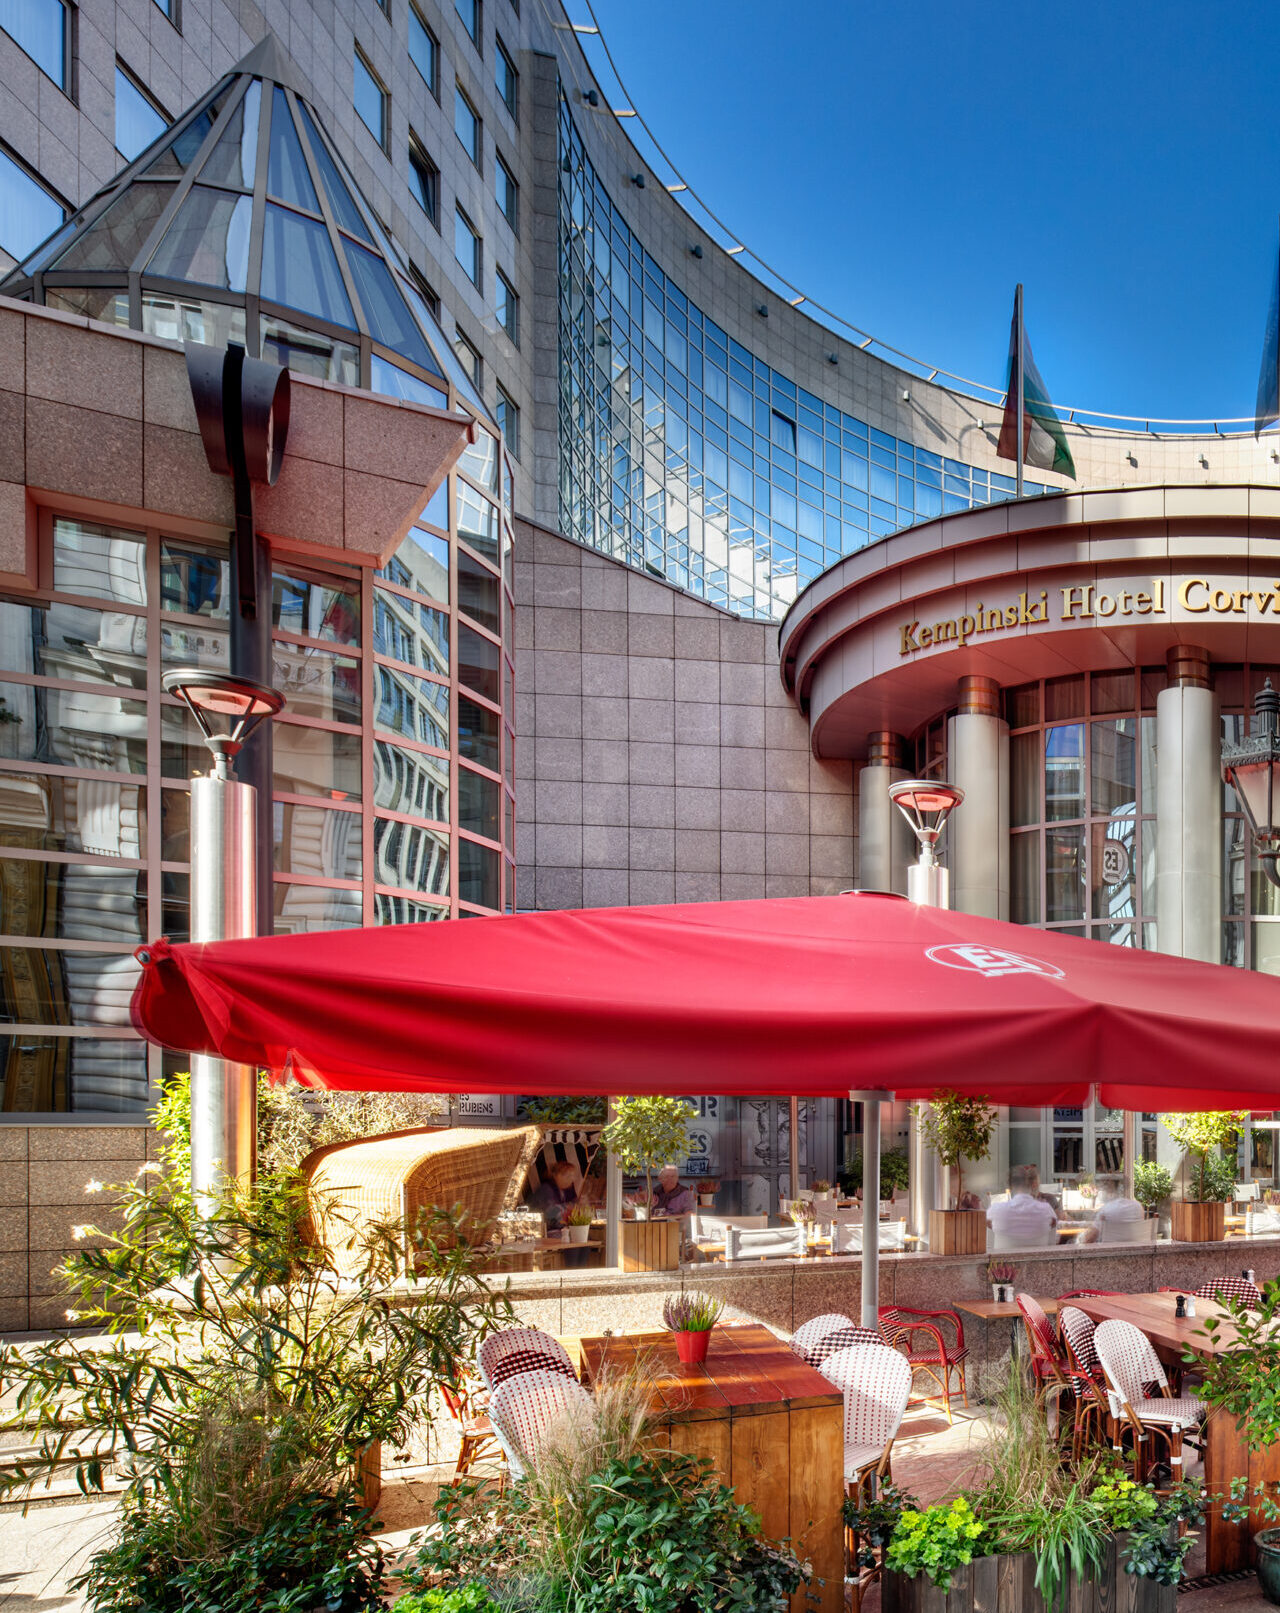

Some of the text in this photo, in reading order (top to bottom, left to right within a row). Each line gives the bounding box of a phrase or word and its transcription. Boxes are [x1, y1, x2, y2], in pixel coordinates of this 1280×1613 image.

[898, 590, 1049, 655] Kempinski
[1060, 579, 1165, 622] Hotel
[460, 1103, 493, 1113] RUBENS
